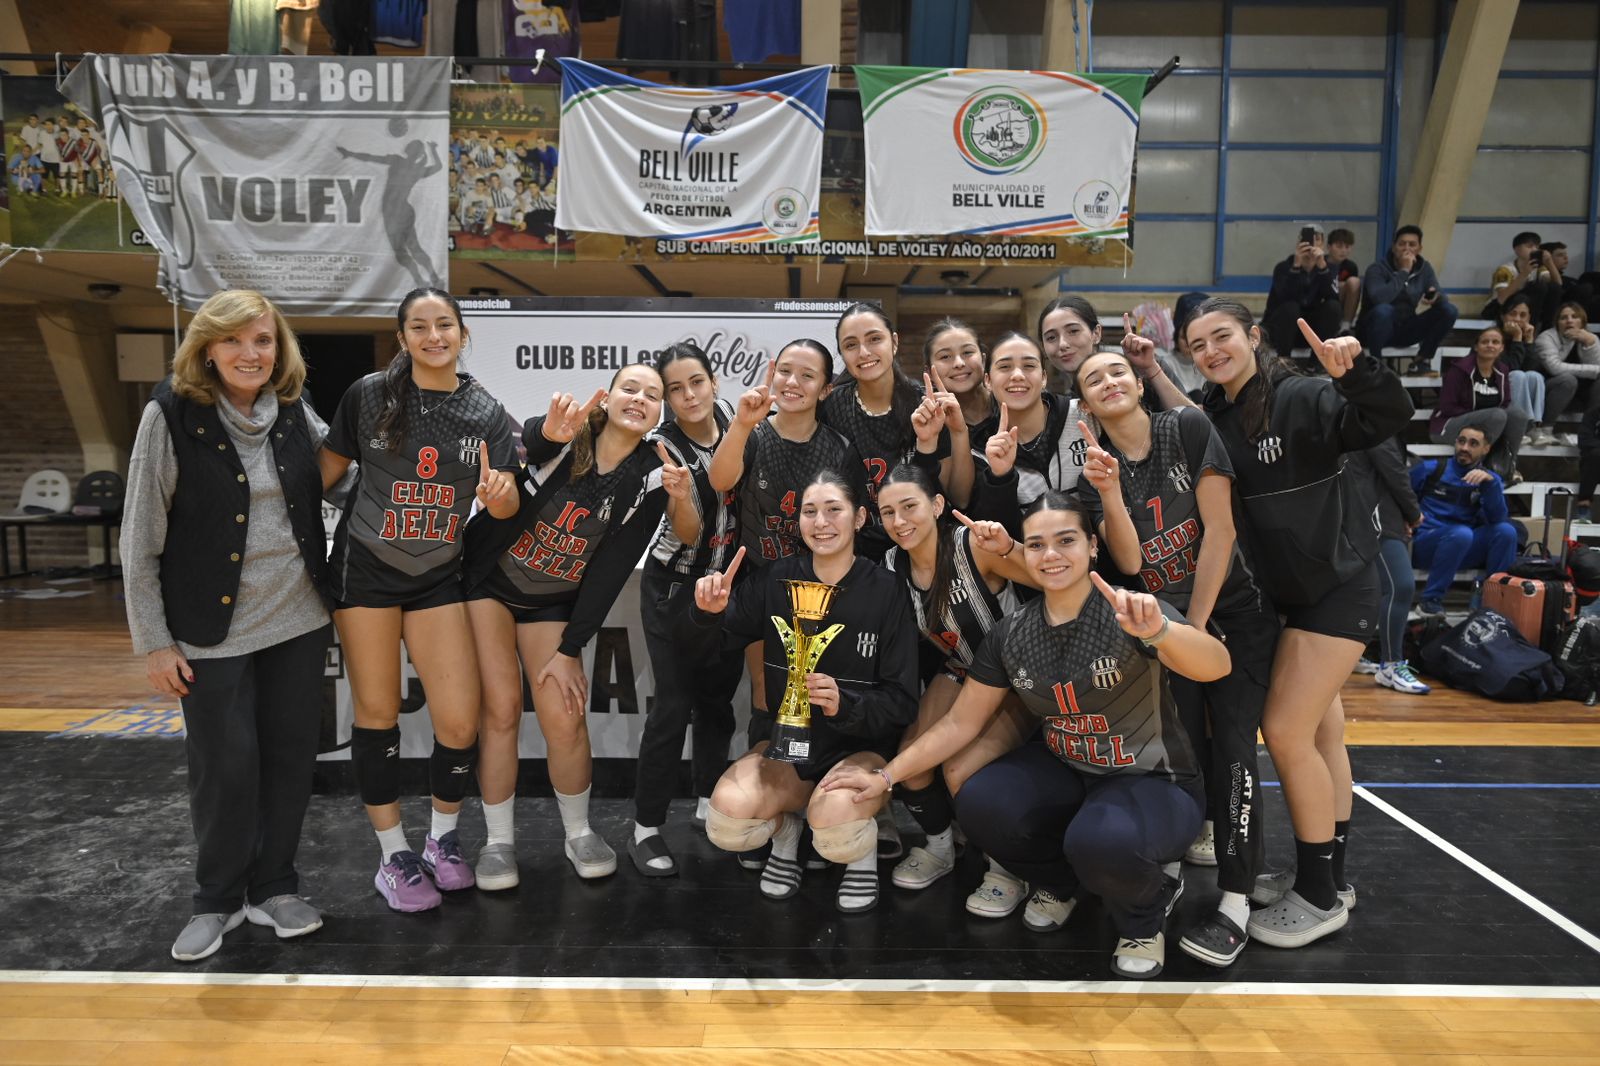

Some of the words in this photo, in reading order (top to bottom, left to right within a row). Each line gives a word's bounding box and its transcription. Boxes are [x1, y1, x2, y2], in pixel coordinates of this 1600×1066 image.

[186, 60, 225, 100] A.
[235, 68, 258, 105] y
[269, 62, 307, 101] B.
[319, 62, 404, 102] Bell
[640, 149, 682, 181] BELL
[688, 151, 739, 182] VILLE
[143, 177, 170, 195] ELL
[201, 175, 371, 223] VOLEY
[639, 181, 670, 192] CAPITAL
[673, 185, 712, 193] NACIONAL
[650, 192, 679, 201] PELOTA
[682, 194, 692, 202] DE
[952, 184, 1030, 193] MUNICIPALIDAD
[1032, 185, 1045, 193] DE
[643, 202, 732, 217] ARGENTINA
[952, 193, 993, 207] BELL
[997, 194, 1045, 208] VILLE
[657, 240, 687, 253] SUB
[690, 242, 761, 254] CAMPEON
[766, 242, 798, 254] LIGA
[802, 242, 874, 255] NACIONAL
[878, 243, 897, 256] DE
[900, 243, 948, 257] VOLEY
[951, 241, 983, 257] AÑO
[986, 244, 1056, 258] 2010/2011
[457, 299, 511, 309] omoselclub
[774, 301, 859, 311] #todossomoselcl
[516, 344, 575, 370] CLUB
[581, 344, 628, 370] BELL
[416, 446, 439, 479] 8
[391, 480, 455, 509] CLUB
[780, 490, 797, 517] 4
[1146, 495, 1164, 532] 7
[534, 520, 588, 556] CLUB
[1141, 518, 1200, 564] CLUB
[508, 529, 587, 583] BELL
[1140, 546, 1198, 593] BEL
[1051, 681, 1080, 714] 11
[1045, 714, 1110, 734] CLUB
[1047, 729, 1136, 768] BELL
